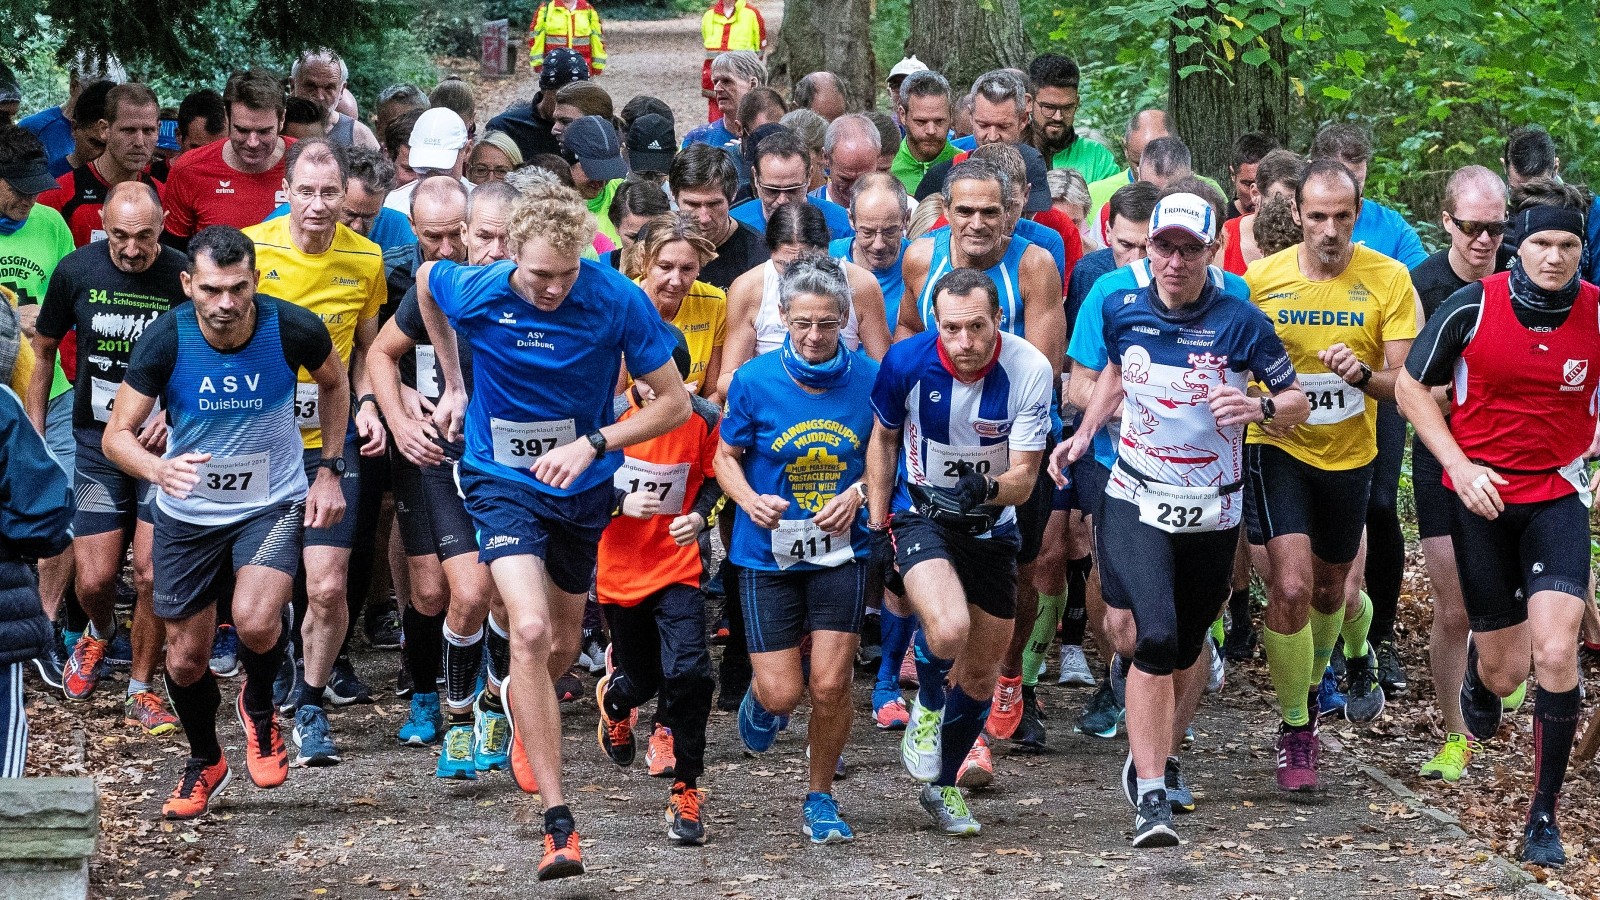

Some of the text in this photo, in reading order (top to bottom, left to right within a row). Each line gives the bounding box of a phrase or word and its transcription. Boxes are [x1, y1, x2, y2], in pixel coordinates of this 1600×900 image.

[1164, 207, 1200, 219] ERDINGER
[0, 267, 30, 280] DDIES
[88, 288, 112, 304] 34.
[113, 297, 171, 311] Schlossparklauf
[1277, 309, 1365, 326] SWEDEN
[527, 331, 545, 339] ASV
[1176, 337, 1214, 347] Düsseldorf
[97, 340, 130, 352] 2011
[516, 339, 555, 350] Duisburg
[1566, 363, 1583, 380] HTV
[198, 397, 263, 410] Duisburg
[1304, 389, 1346, 411] 341
[494, 425, 554, 435] Jungbornparklauf
[770, 418, 861, 452] TRAININGSGRUPPE
[509, 437, 558, 457] 397
[793, 432, 842, 450] MUDDIES
[791, 463, 840, 472] MUD MASTERS
[206, 471, 253, 491] 327
[788, 471, 841, 482] OBSTACLE RUN
[791, 481, 838, 491] AIRPORT WEEZE
[1144, 487, 1203, 501] Jungbornparklauf
[1156, 502, 1204, 527] 232
[789, 533, 832, 560] 411
